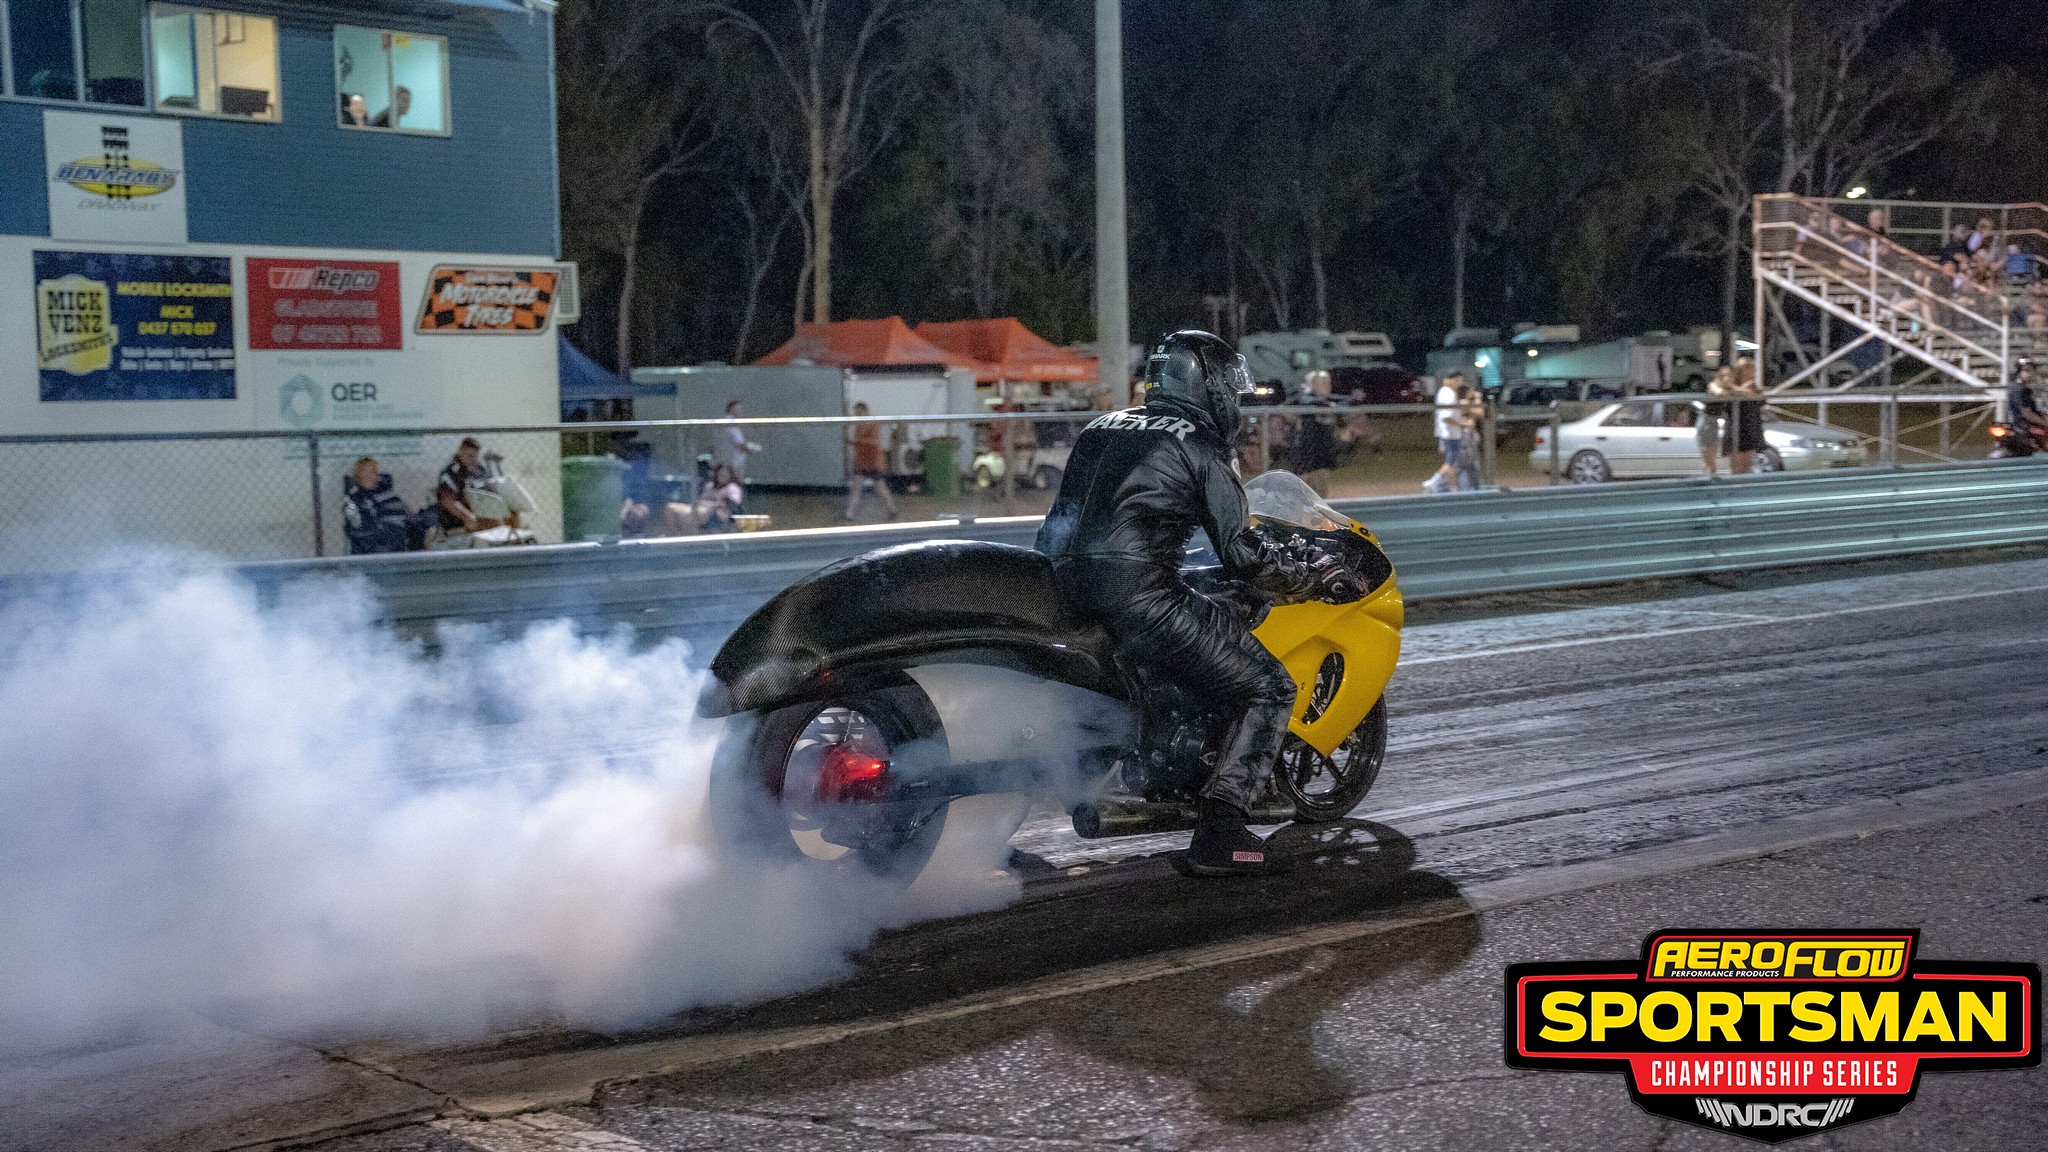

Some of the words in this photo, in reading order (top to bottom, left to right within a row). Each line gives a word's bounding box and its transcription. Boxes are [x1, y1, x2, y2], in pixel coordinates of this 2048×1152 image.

[57, 165, 174, 184] BENARABY
[313, 268, 378, 291] Repco
[47, 290, 102, 310] MICK
[48, 314, 102, 333] VENZ
[464, 304, 514, 327] TYRES
[1234, 852, 1262, 861] SIMPSON
